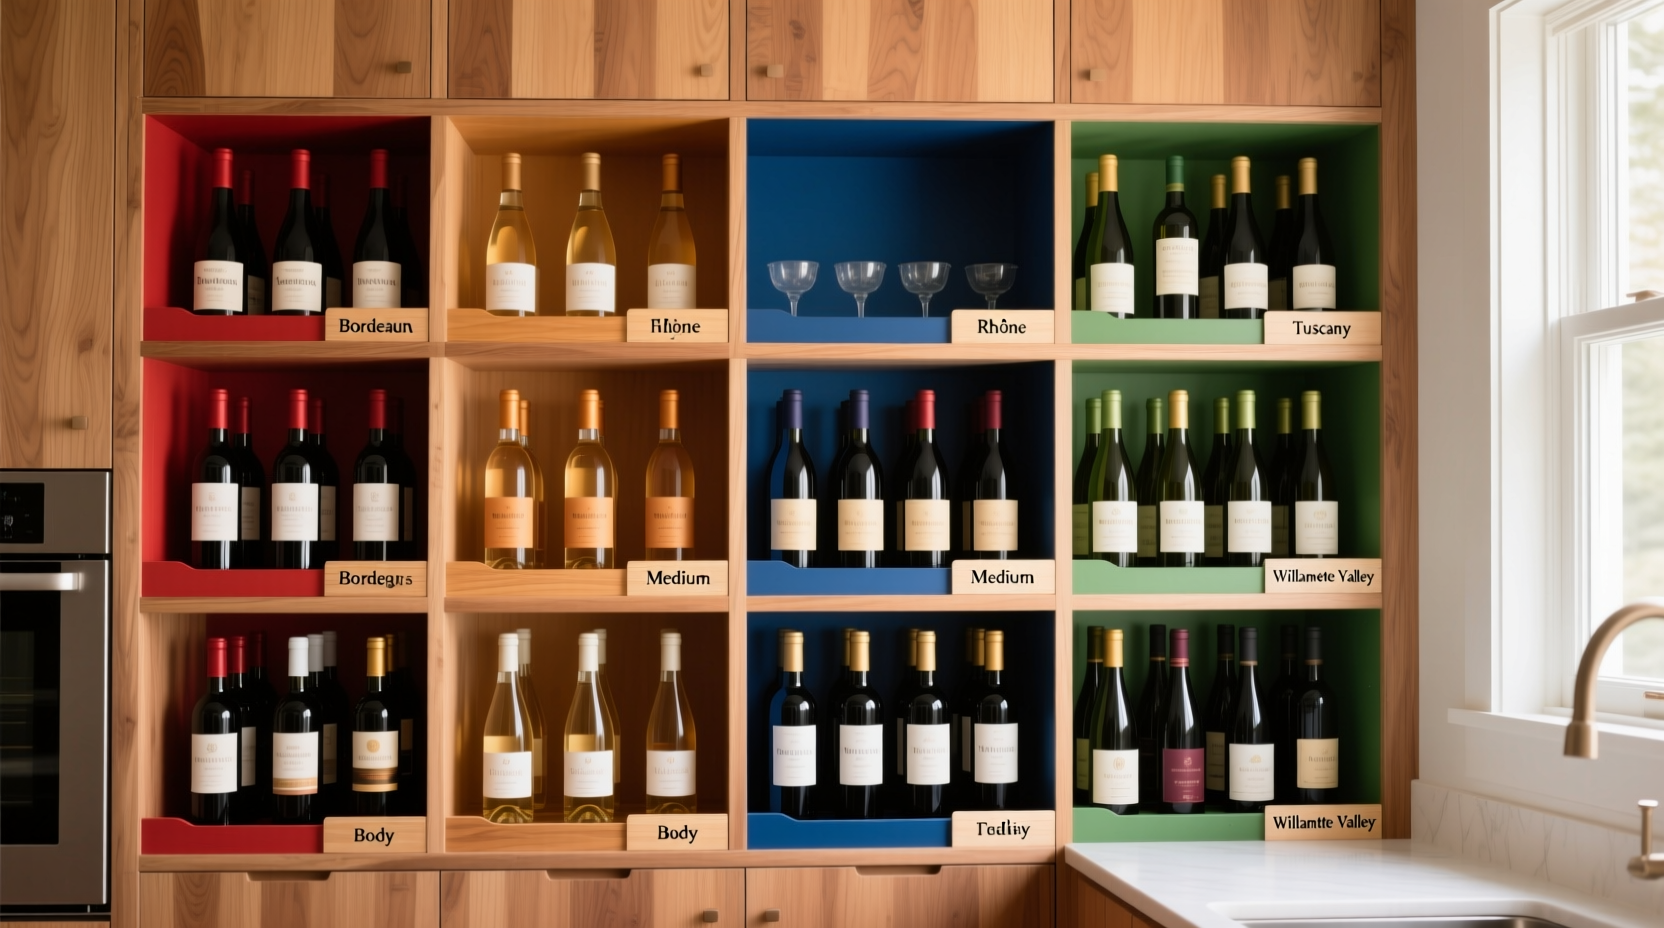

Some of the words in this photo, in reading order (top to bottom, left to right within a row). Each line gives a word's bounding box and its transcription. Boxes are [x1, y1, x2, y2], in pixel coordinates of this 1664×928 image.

[977, 318, 1027, 334] Rhône
[1292, 320, 1352, 340] Tuscany
[646, 569, 711, 585] Medium
[971, 569, 1035, 584] Medium
[1336, 814, 1377, 833] Valley
[355, 826, 394, 847] Body
[658, 824, 698, 845] Body
